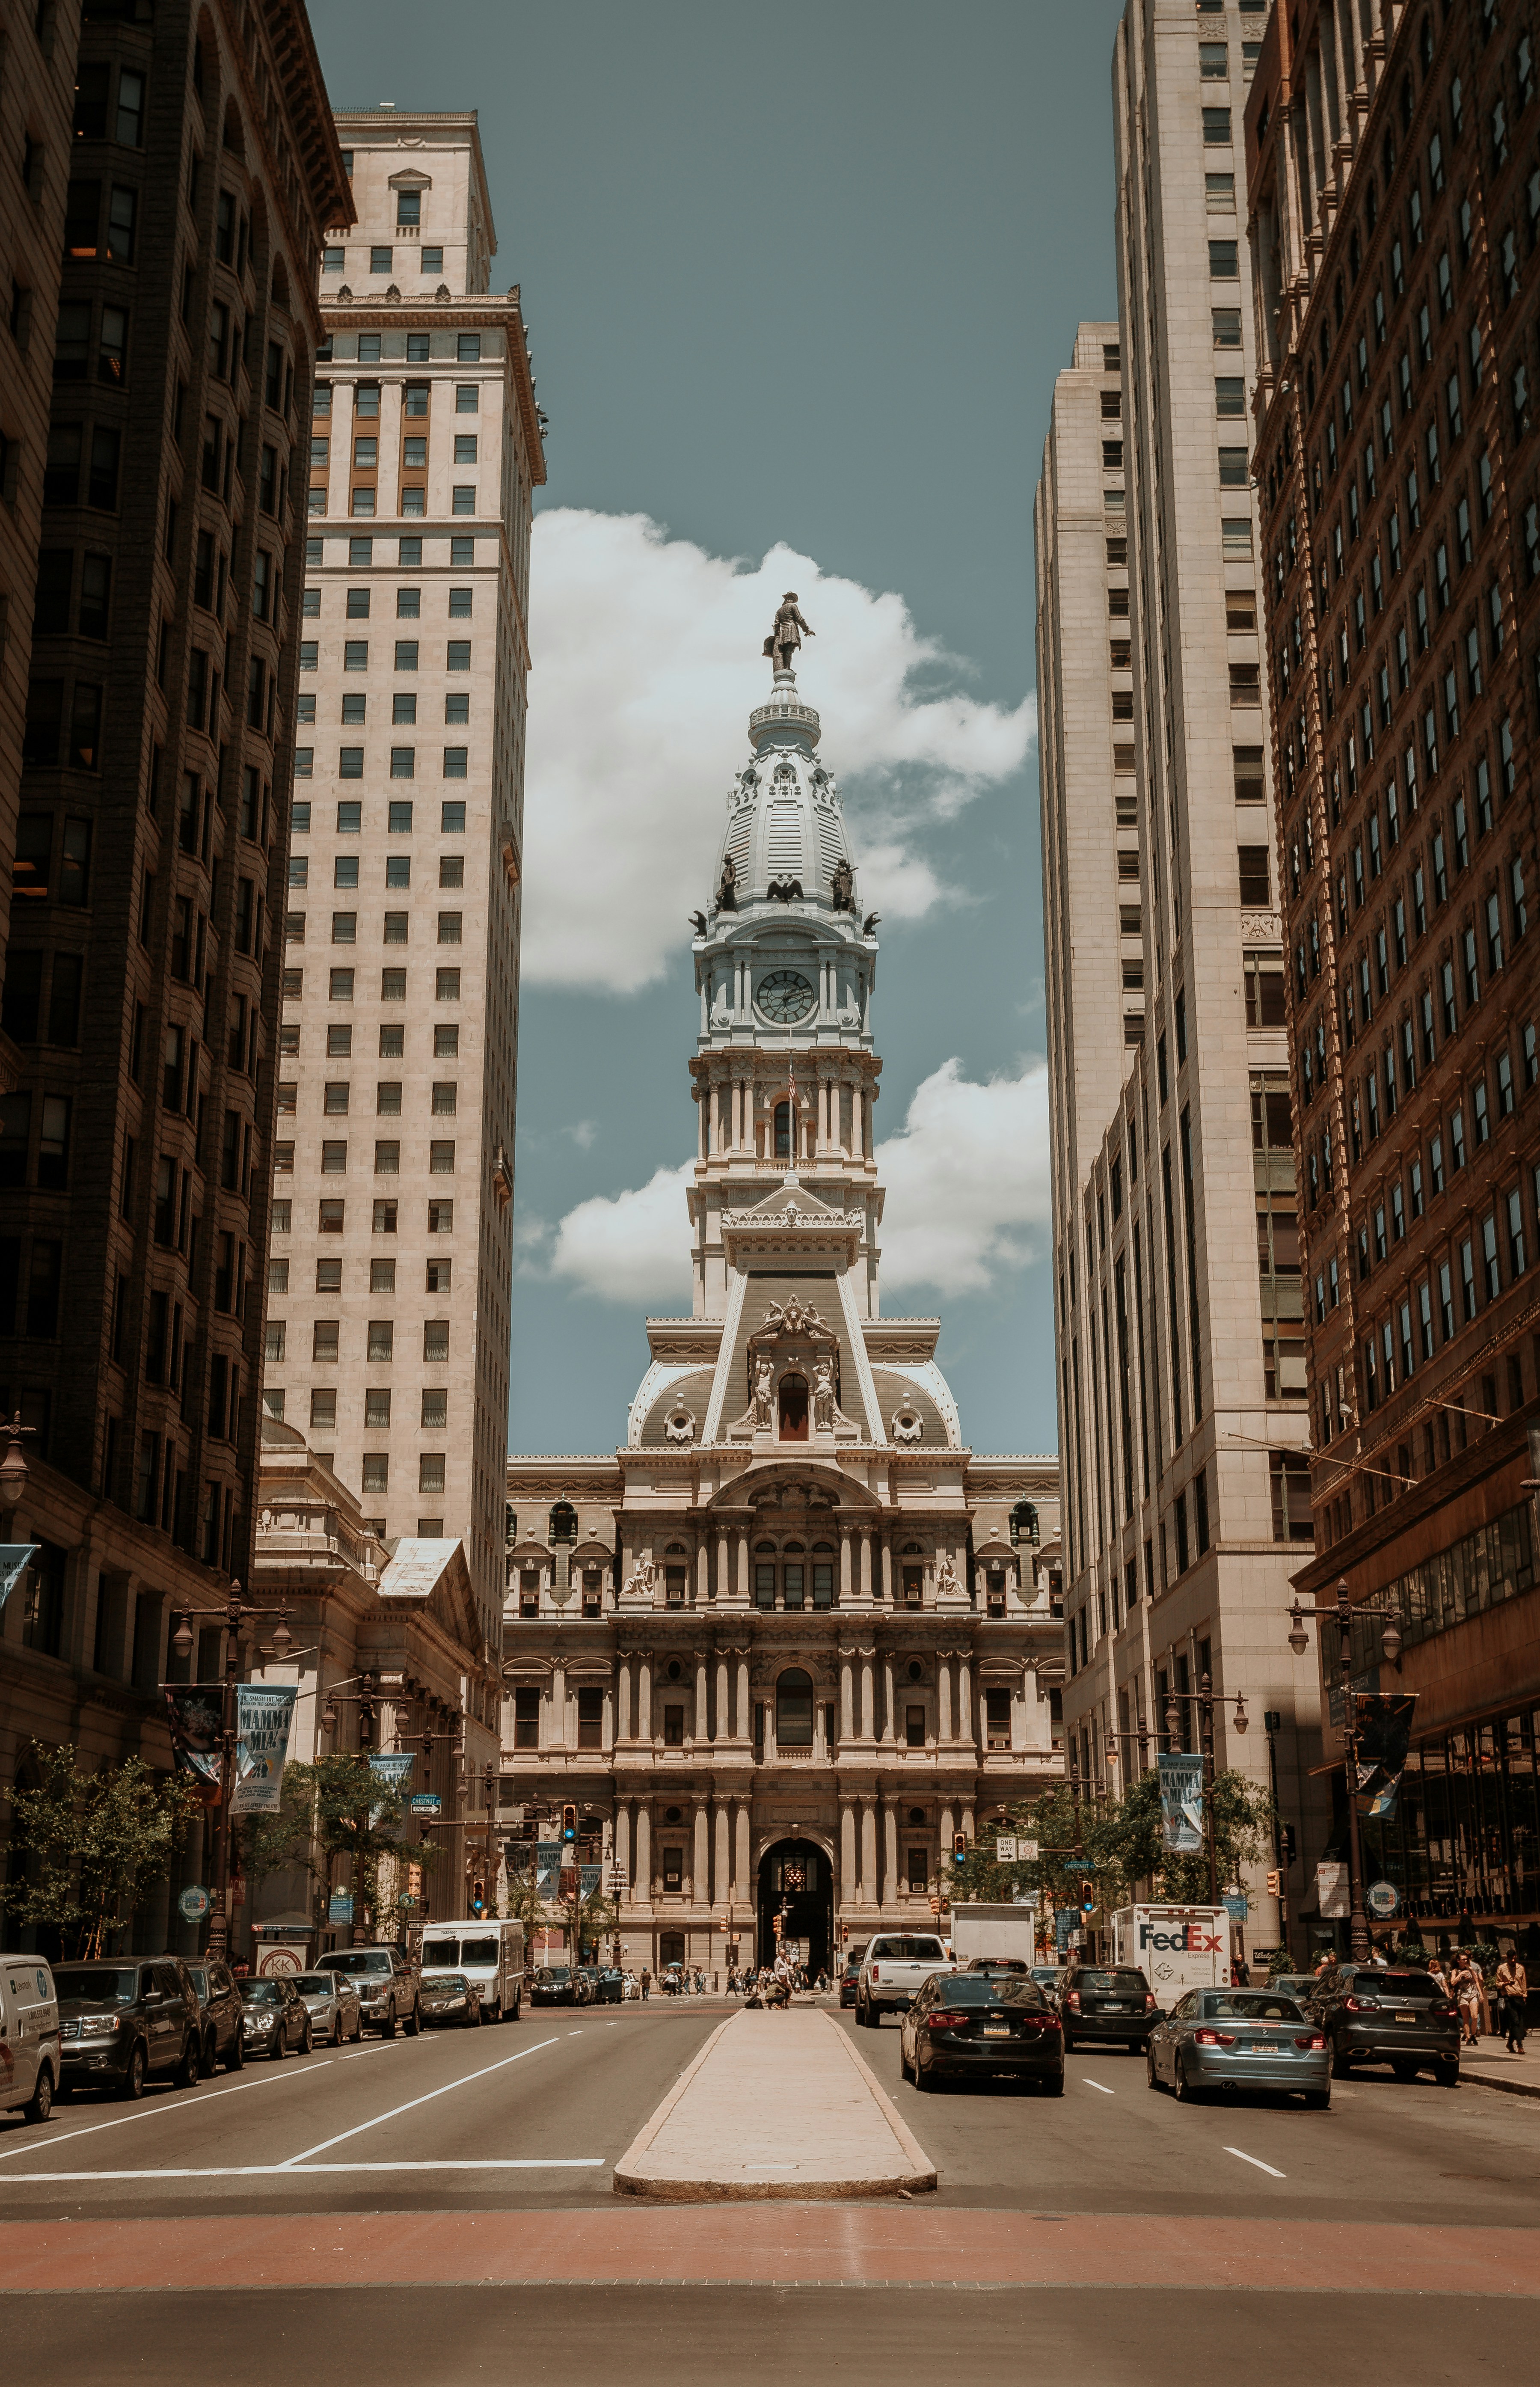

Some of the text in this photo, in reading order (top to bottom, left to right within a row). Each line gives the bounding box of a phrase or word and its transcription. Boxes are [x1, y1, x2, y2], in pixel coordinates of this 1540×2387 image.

[240, 1709, 289, 1730] MAMMA
[249, 1730, 279, 1750] MIA!
[1160, 1772, 1200, 1788] MAMMA
[1169, 1788, 1192, 1804] MIA!
[539, 1853, 561, 1862] MAMMA
[1139, 1924, 1223, 1952] FedEx
[1254, 1952, 1275, 1960] Walgr
[271, 1959, 291, 1971] KK
[17, 1979, 33, 1991] Lexmark
